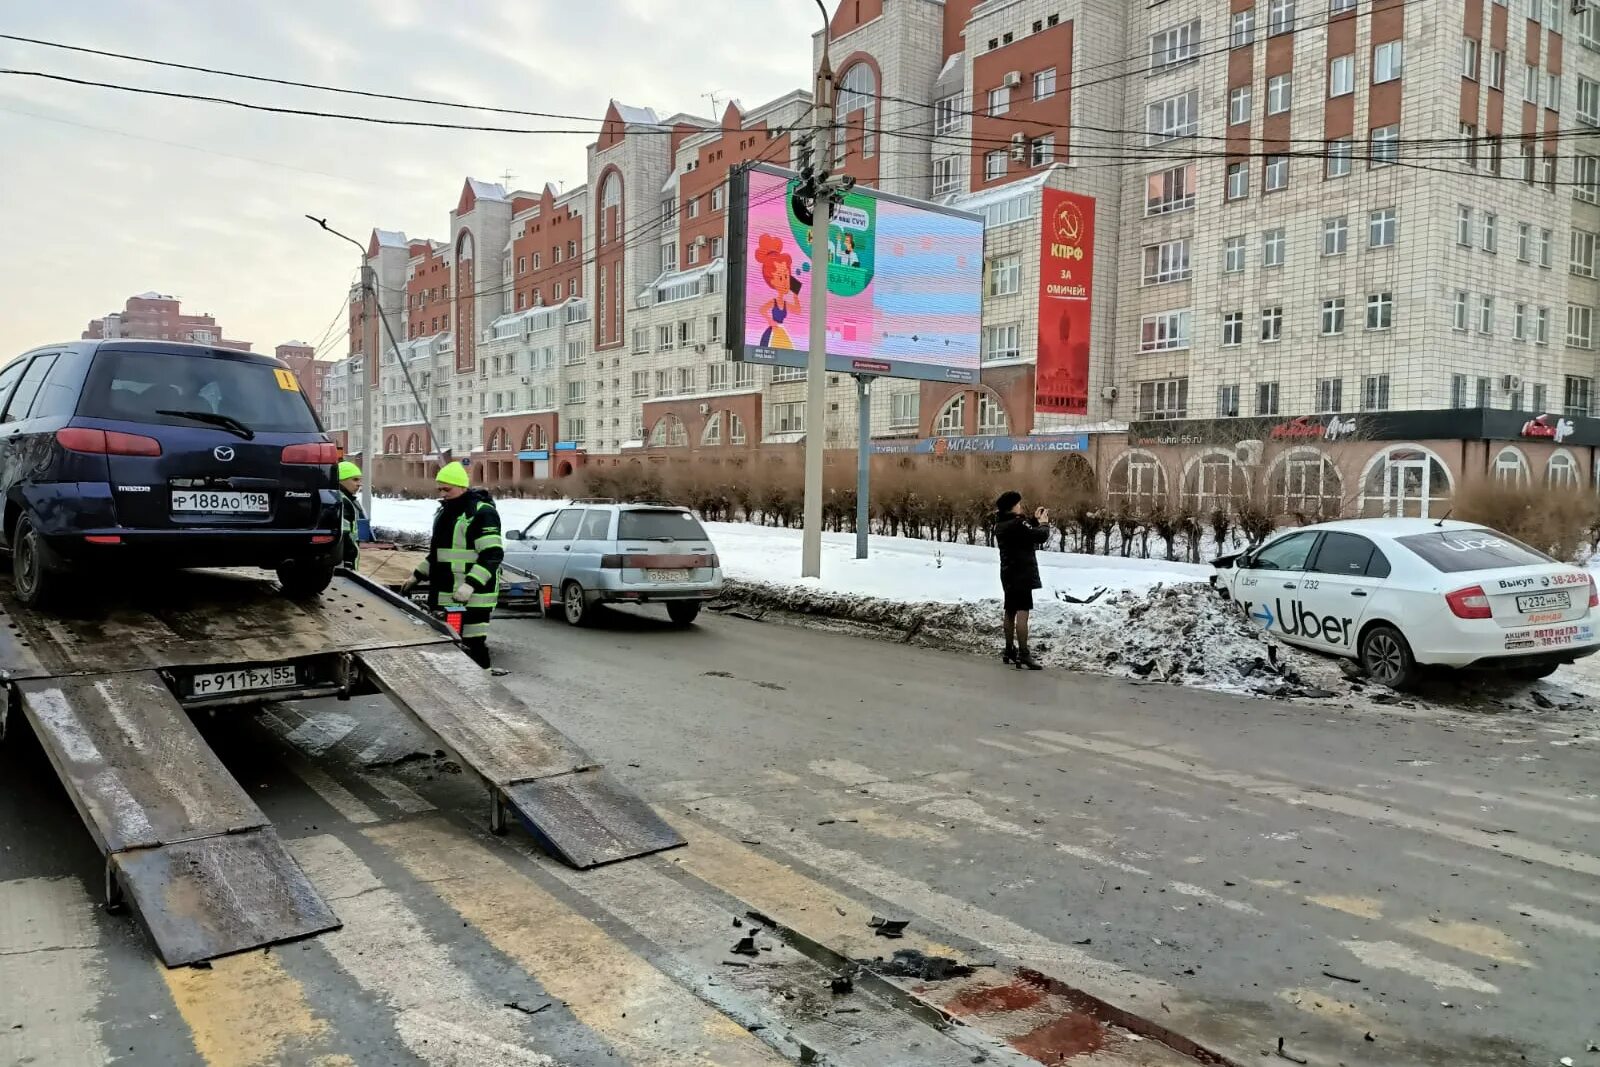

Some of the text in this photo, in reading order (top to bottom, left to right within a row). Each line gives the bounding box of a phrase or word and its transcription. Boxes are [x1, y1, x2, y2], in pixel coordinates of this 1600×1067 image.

[1051, 243, 1083, 261] КПРФ
[1060, 269, 1072, 280] ЗА
[1046, 283, 1086, 296] ОМИЧЕЙ!
[1242, 577, 1258, 587] Uber
[1303, 579, 1320, 590] 232
[1499, 577, 1534, 589] Выкуп
[1275, 597, 1353, 646] Uber
[1528, 612, 1563, 623] Аренда
[1505, 631, 1530, 640] АКЦИЯ
[1534, 628, 1554, 638] АВТО
[273, 667, 290, 680] 55
